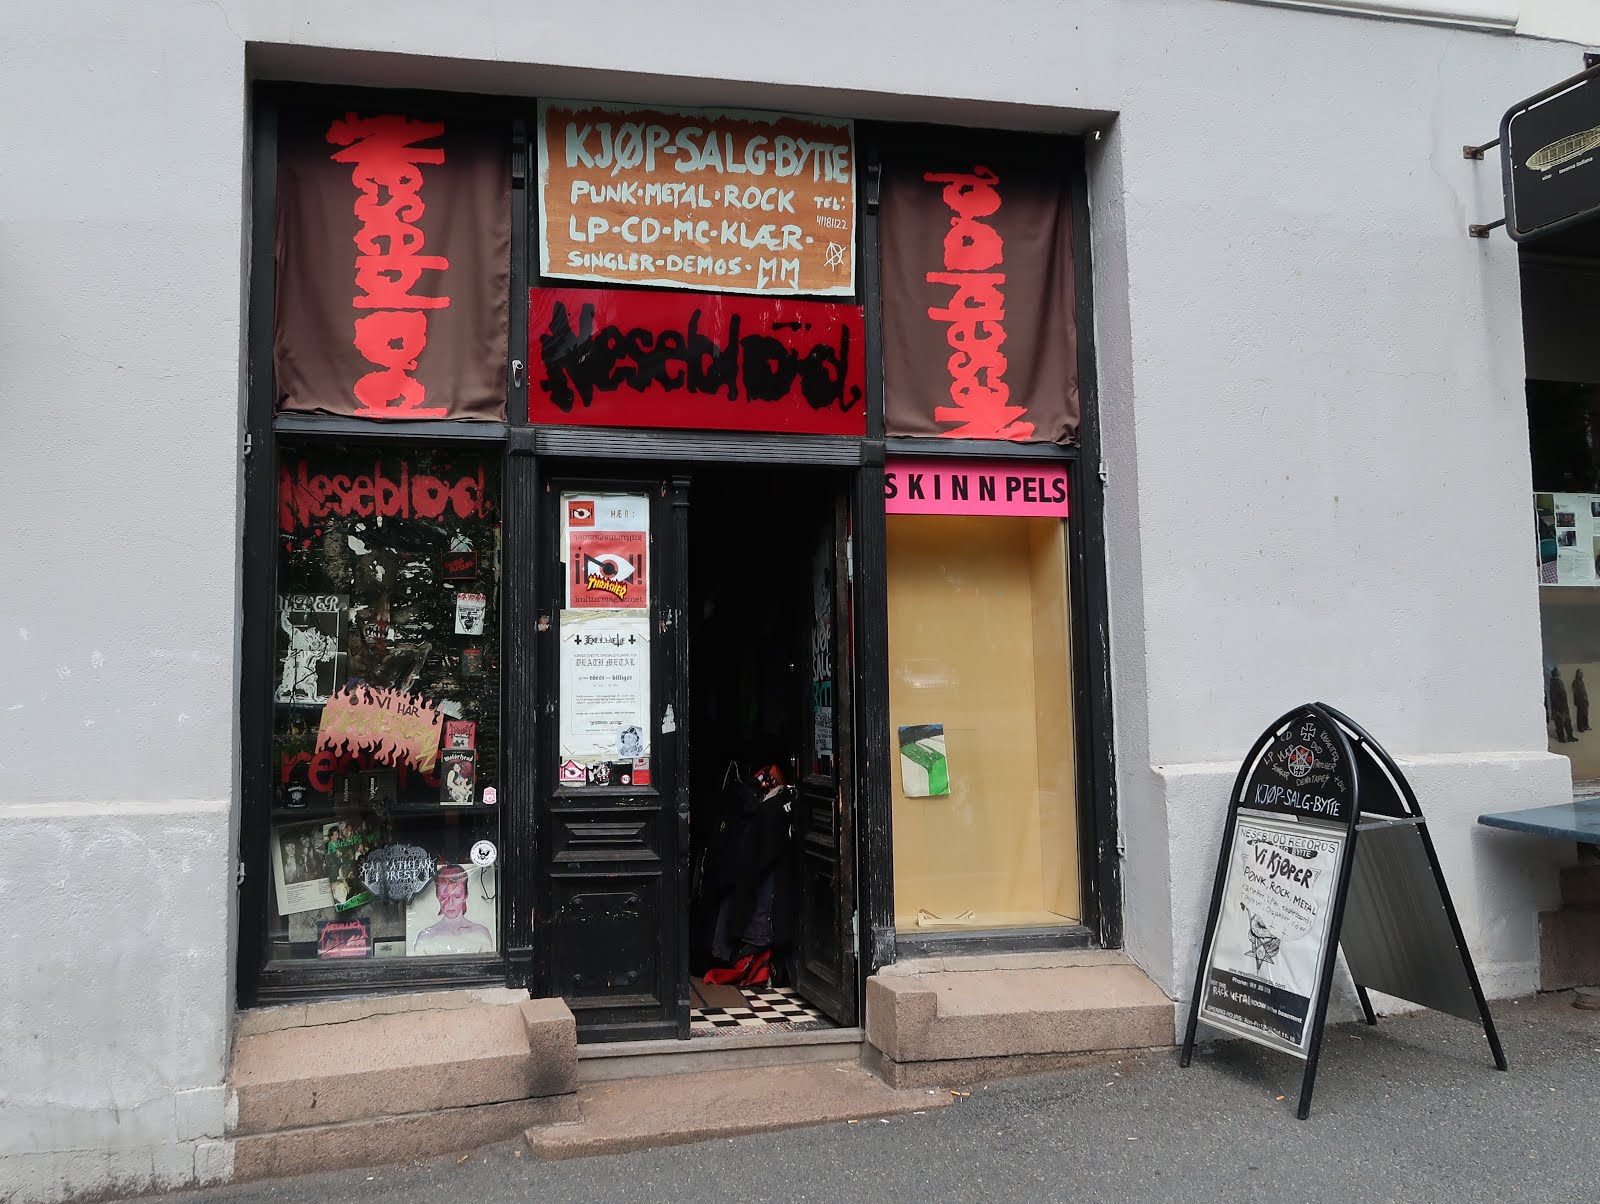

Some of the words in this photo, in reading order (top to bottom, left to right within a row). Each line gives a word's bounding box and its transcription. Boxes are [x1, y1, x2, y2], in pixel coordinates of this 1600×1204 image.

[884, 473, 996, 501] SKINN
[1006, 476, 1067, 504] PELS
[587, 576, 627, 599] THRASHER
[375, 695, 392, 710] VI
[397, 702, 421, 718] HAR
[1280, 731, 1293, 741] CD
[1263, 751, 1274, 765] LP
[1255, 784, 1341, 816] KJØP-SALG-BYTTE
[1288, 838, 1336, 854] RECORDS
[1293, 895, 1317, 915] METAL
